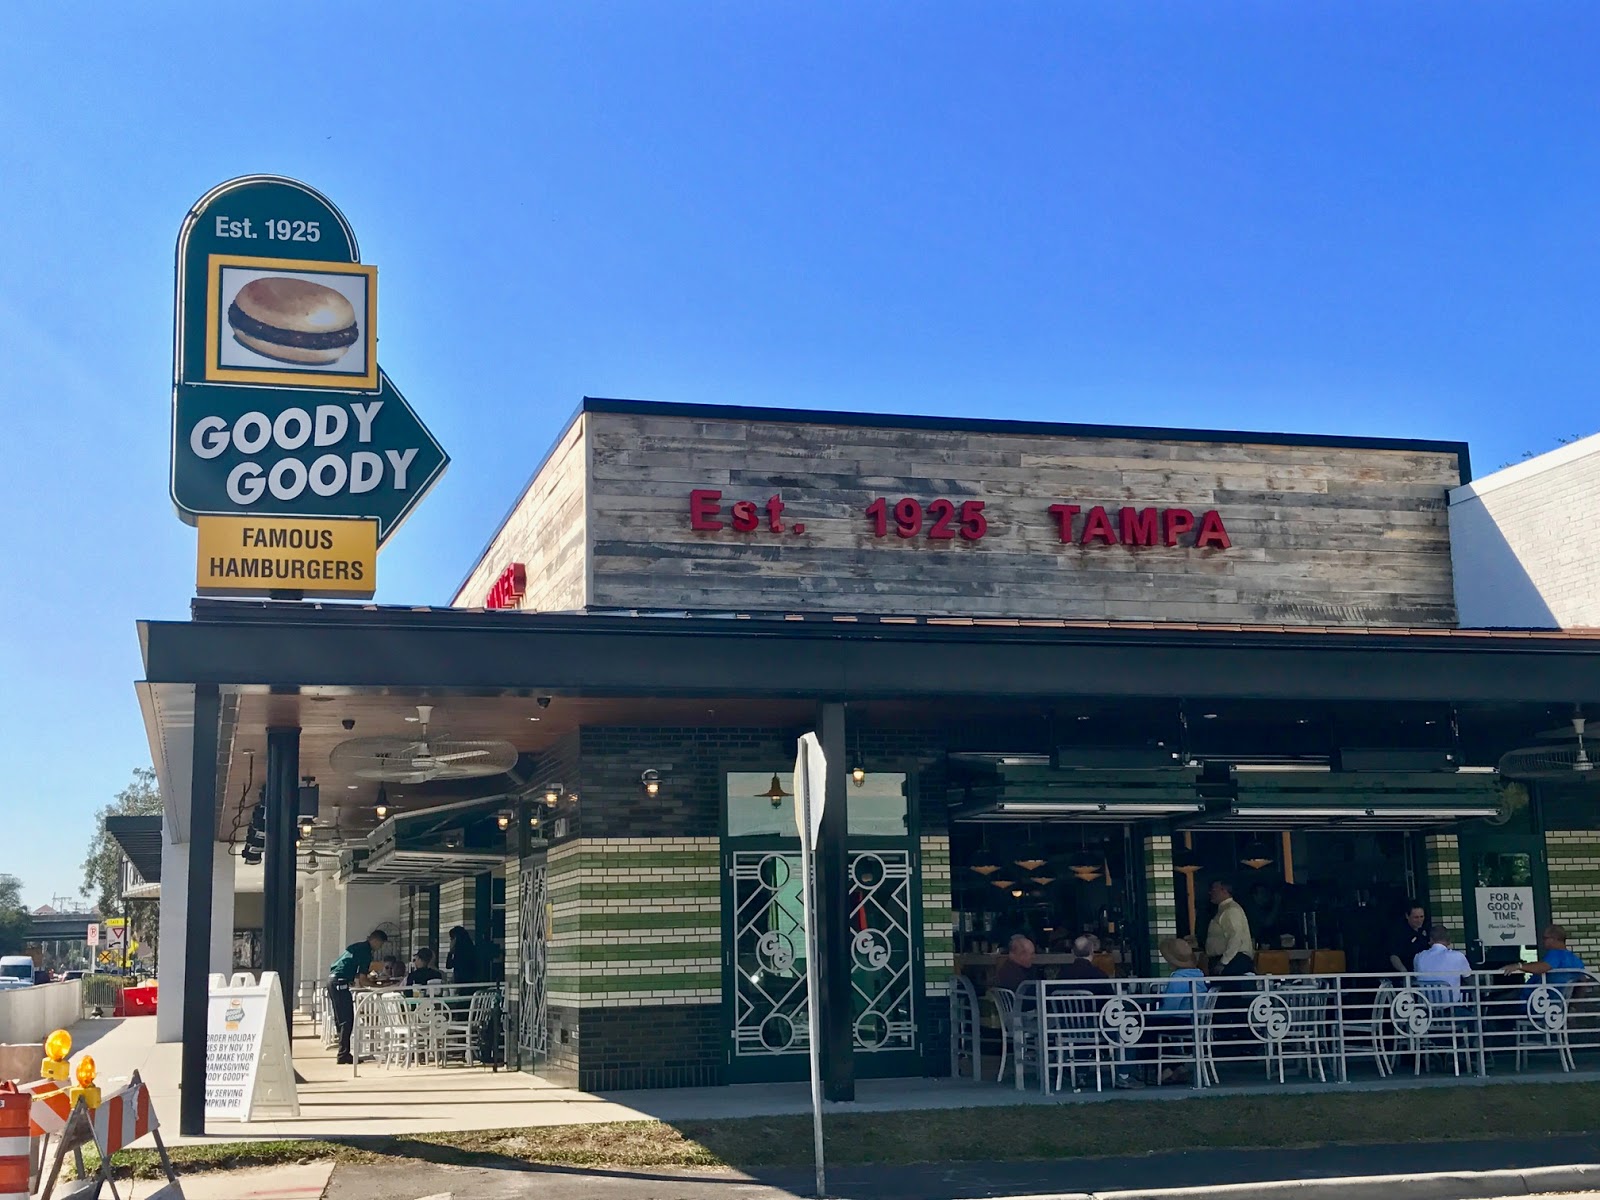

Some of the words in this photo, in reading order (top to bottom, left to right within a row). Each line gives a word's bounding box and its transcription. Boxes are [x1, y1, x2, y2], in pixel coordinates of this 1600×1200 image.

[215, 215, 258, 239] Est.
[265, 219, 321, 242] 1925
[190, 401, 385, 459] GOODY
[226, 448, 420, 505] GOODY
[689, 489, 806, 534] Est.
[866, 497, 988, 540] 1925
[1048, 503, 1232, 549] TAMPA
[242, 528, 334, 549] FAMOUS
[209, 557, 364, 580] HAMBURGERS
[1489, 892, 1510, 901] FOR
[1513, 892, 1520, 901] A
[1487, 902, 1524, 911] GOODY
[1493, 911, 1520, 921] TIME,
[228, 1033, 256, 1042] HOLIDAY
[219, 1043, 228, 1051] BY
[206, 1053, 215, 1061] ND
[216, 1053, 235, 1061] MAKE
[236, 1053, 254, 1061] YOUR
[206, 1063, 250, 1071] HANKSGIVING
[215, 1089, 243, 1097] SERVING
